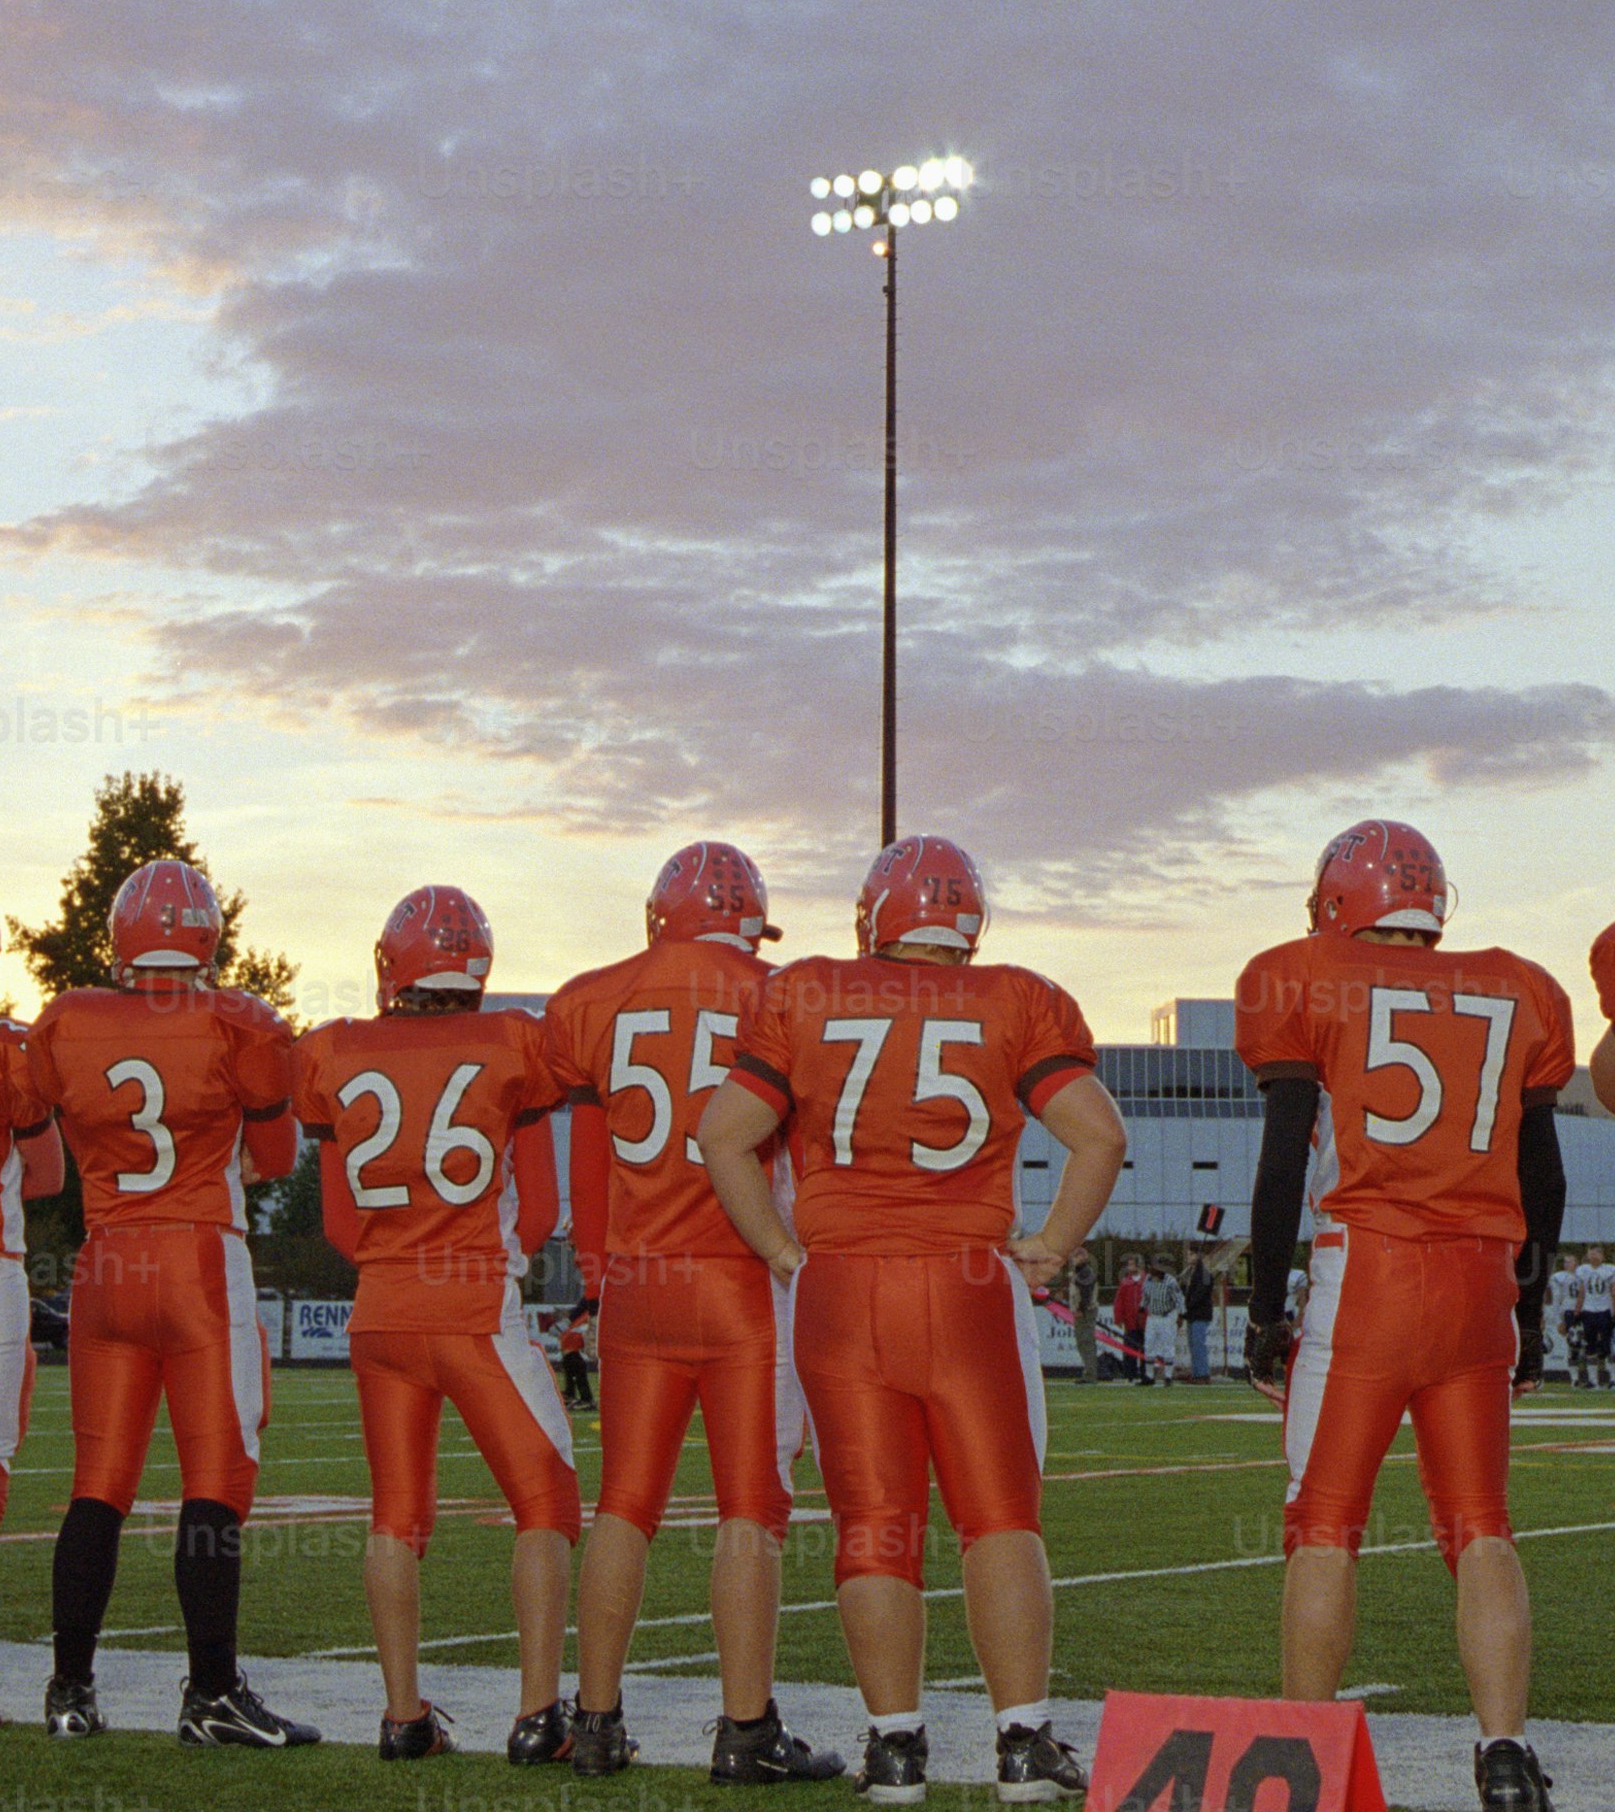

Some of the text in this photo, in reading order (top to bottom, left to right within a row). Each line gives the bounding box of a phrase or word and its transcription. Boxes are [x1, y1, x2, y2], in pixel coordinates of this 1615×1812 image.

[708, 883, 744, 913] 55
[924, 877, 962, 906] 75
[1399, 863, 1434, 893] 57
[822, 1019, 991, 1171] 75
[1365, 987, 1517, 1152] 57
[105, 1057, 177, 1193] 3
[337, 1063, 495, 1206] 26
[1205, 1205, 1217, 1230] 1
